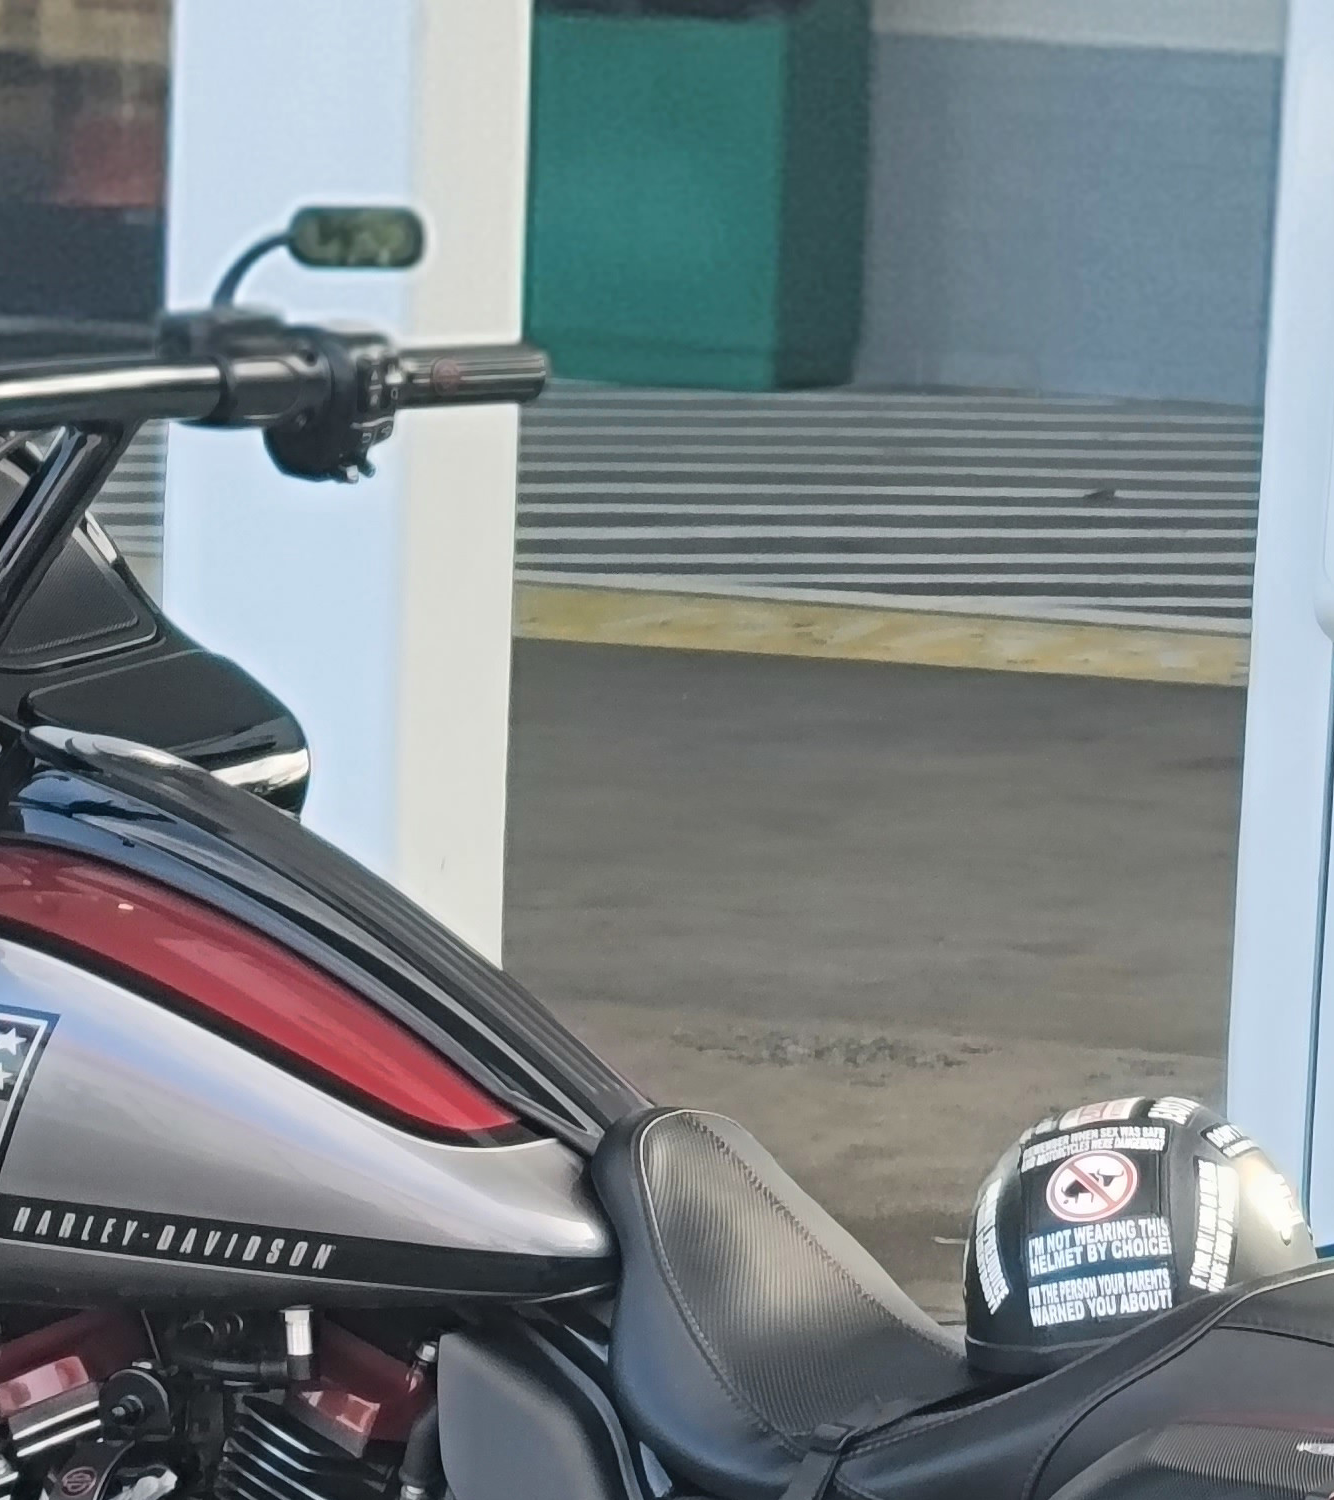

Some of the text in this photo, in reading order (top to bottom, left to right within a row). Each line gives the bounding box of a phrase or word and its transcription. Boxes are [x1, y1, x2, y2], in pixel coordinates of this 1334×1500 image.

[13, 1206, 333, 1270] HARLEY-DAVIDSON
[1029, 1216, 1169, 1260] I'M NOT WEARING THIS
[1029, 1237, 1172, 1277] HELMET BY CHOICE!
[1041, 1282, 1060, 1304] THE
[1060, 1276, 1098, 1302] PERSON
[1098, 1272, 1125, 1297] YOUR
[1126, 1268, 1170, 1294] PARENTS
[1030, 1289, 1172, 1327] WARNED YOU ABOUT!
